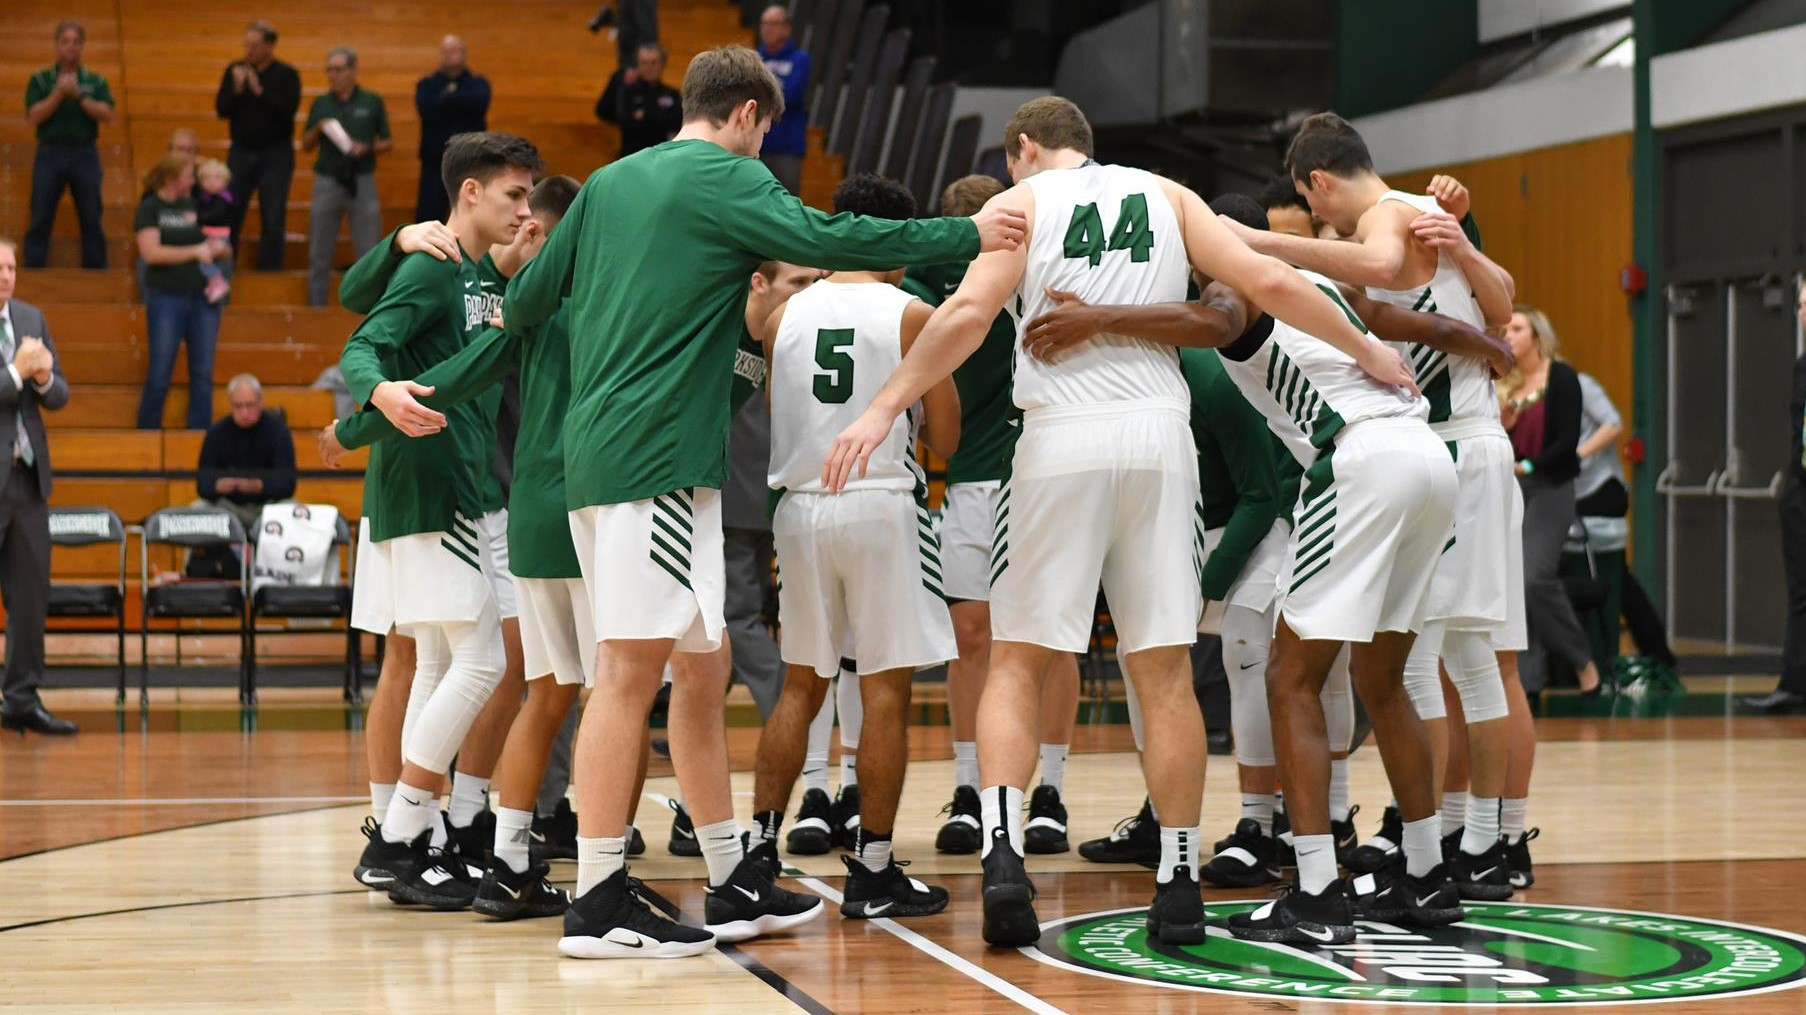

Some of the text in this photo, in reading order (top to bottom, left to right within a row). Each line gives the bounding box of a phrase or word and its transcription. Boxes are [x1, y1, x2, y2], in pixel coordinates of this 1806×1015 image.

[1063, 193, 1154, 270] 44
[813, 328, 855, 404] 5
[1504, 909, 1692, 931] LAKES
[1084, 947, 1419, 997] CONFERENCE
